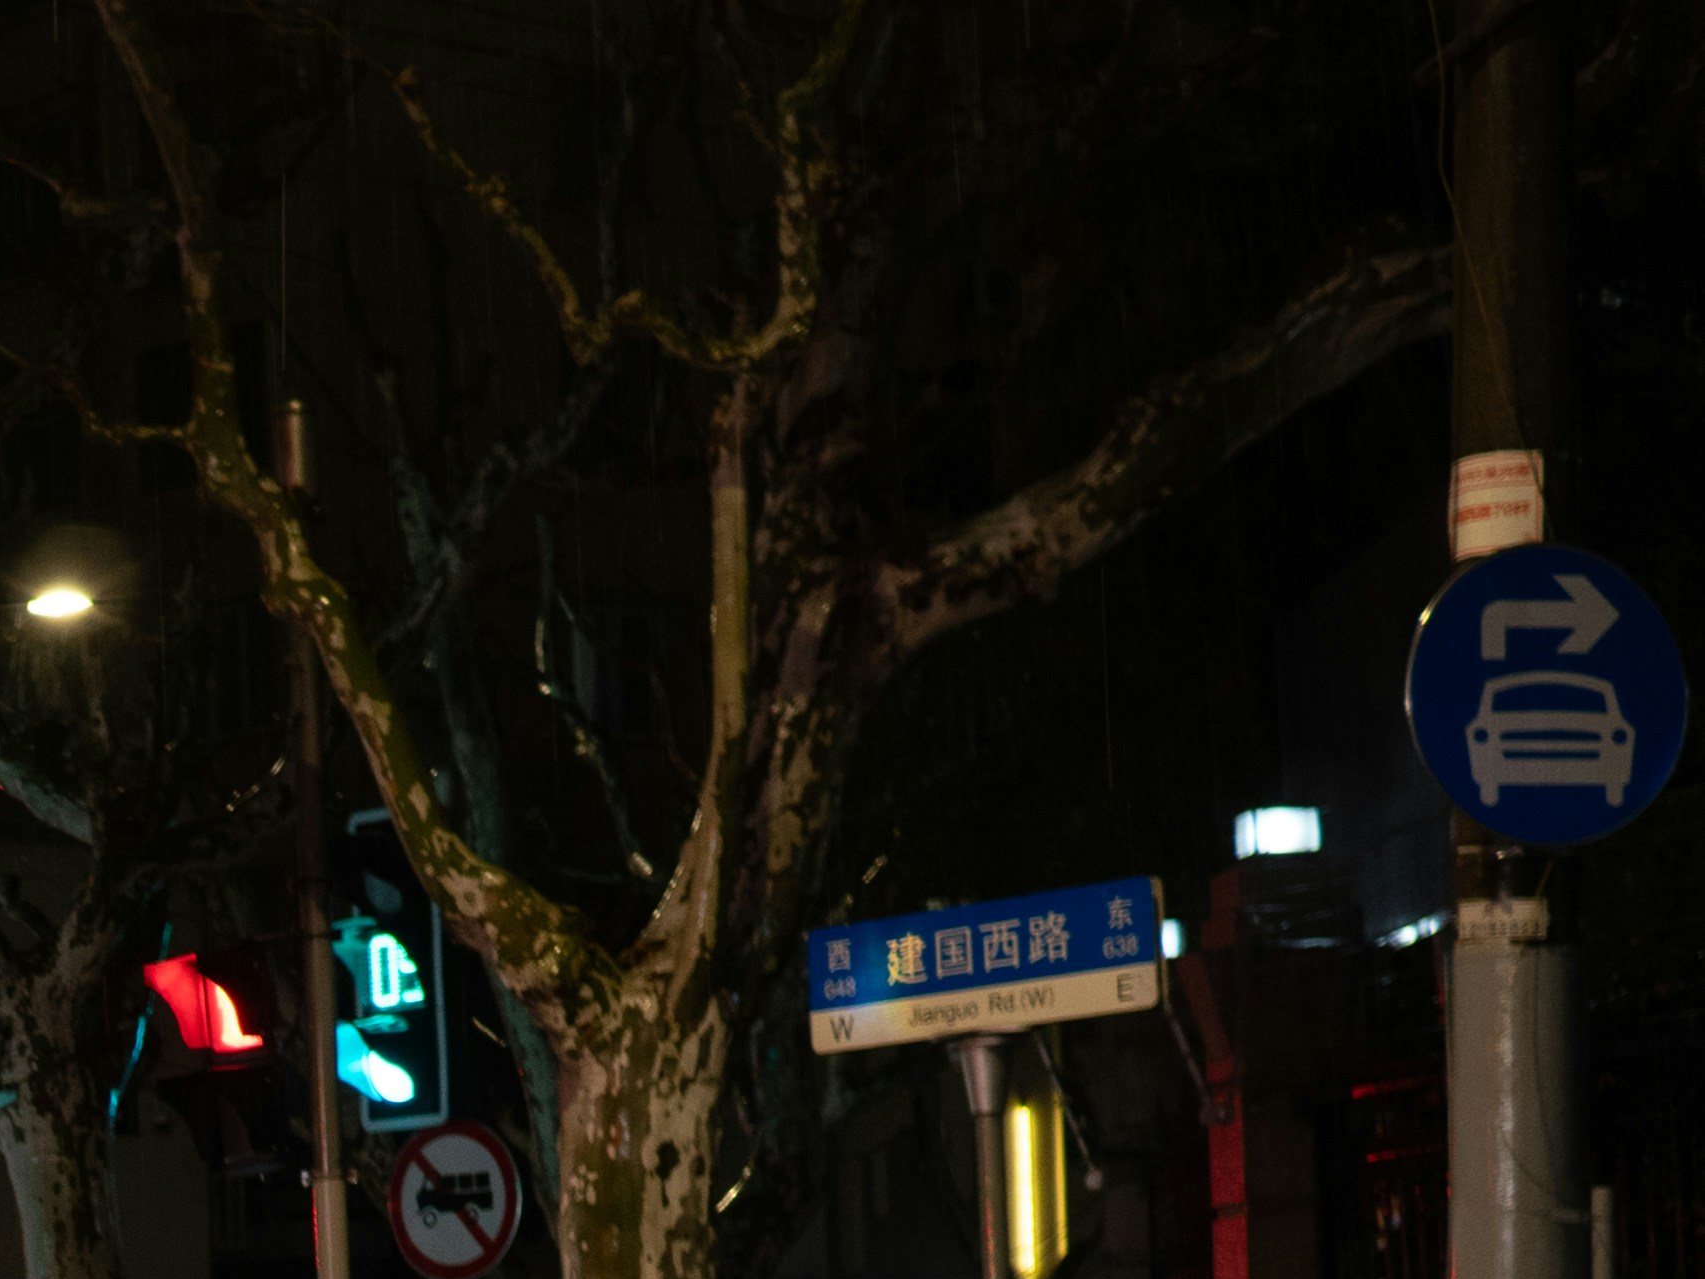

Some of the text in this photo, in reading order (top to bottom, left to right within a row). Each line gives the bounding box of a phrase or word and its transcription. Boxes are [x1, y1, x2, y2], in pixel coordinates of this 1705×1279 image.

[1106, 894, 1134, 931] 东
[826, 938, 852, 974] 西
[886, 911, 1071, 987] 建国西路
[1116, 974, 1134, 1002] E
[829, 1014, 855, 1042] W
[908, 1001, 979, 1027] Jianguo
